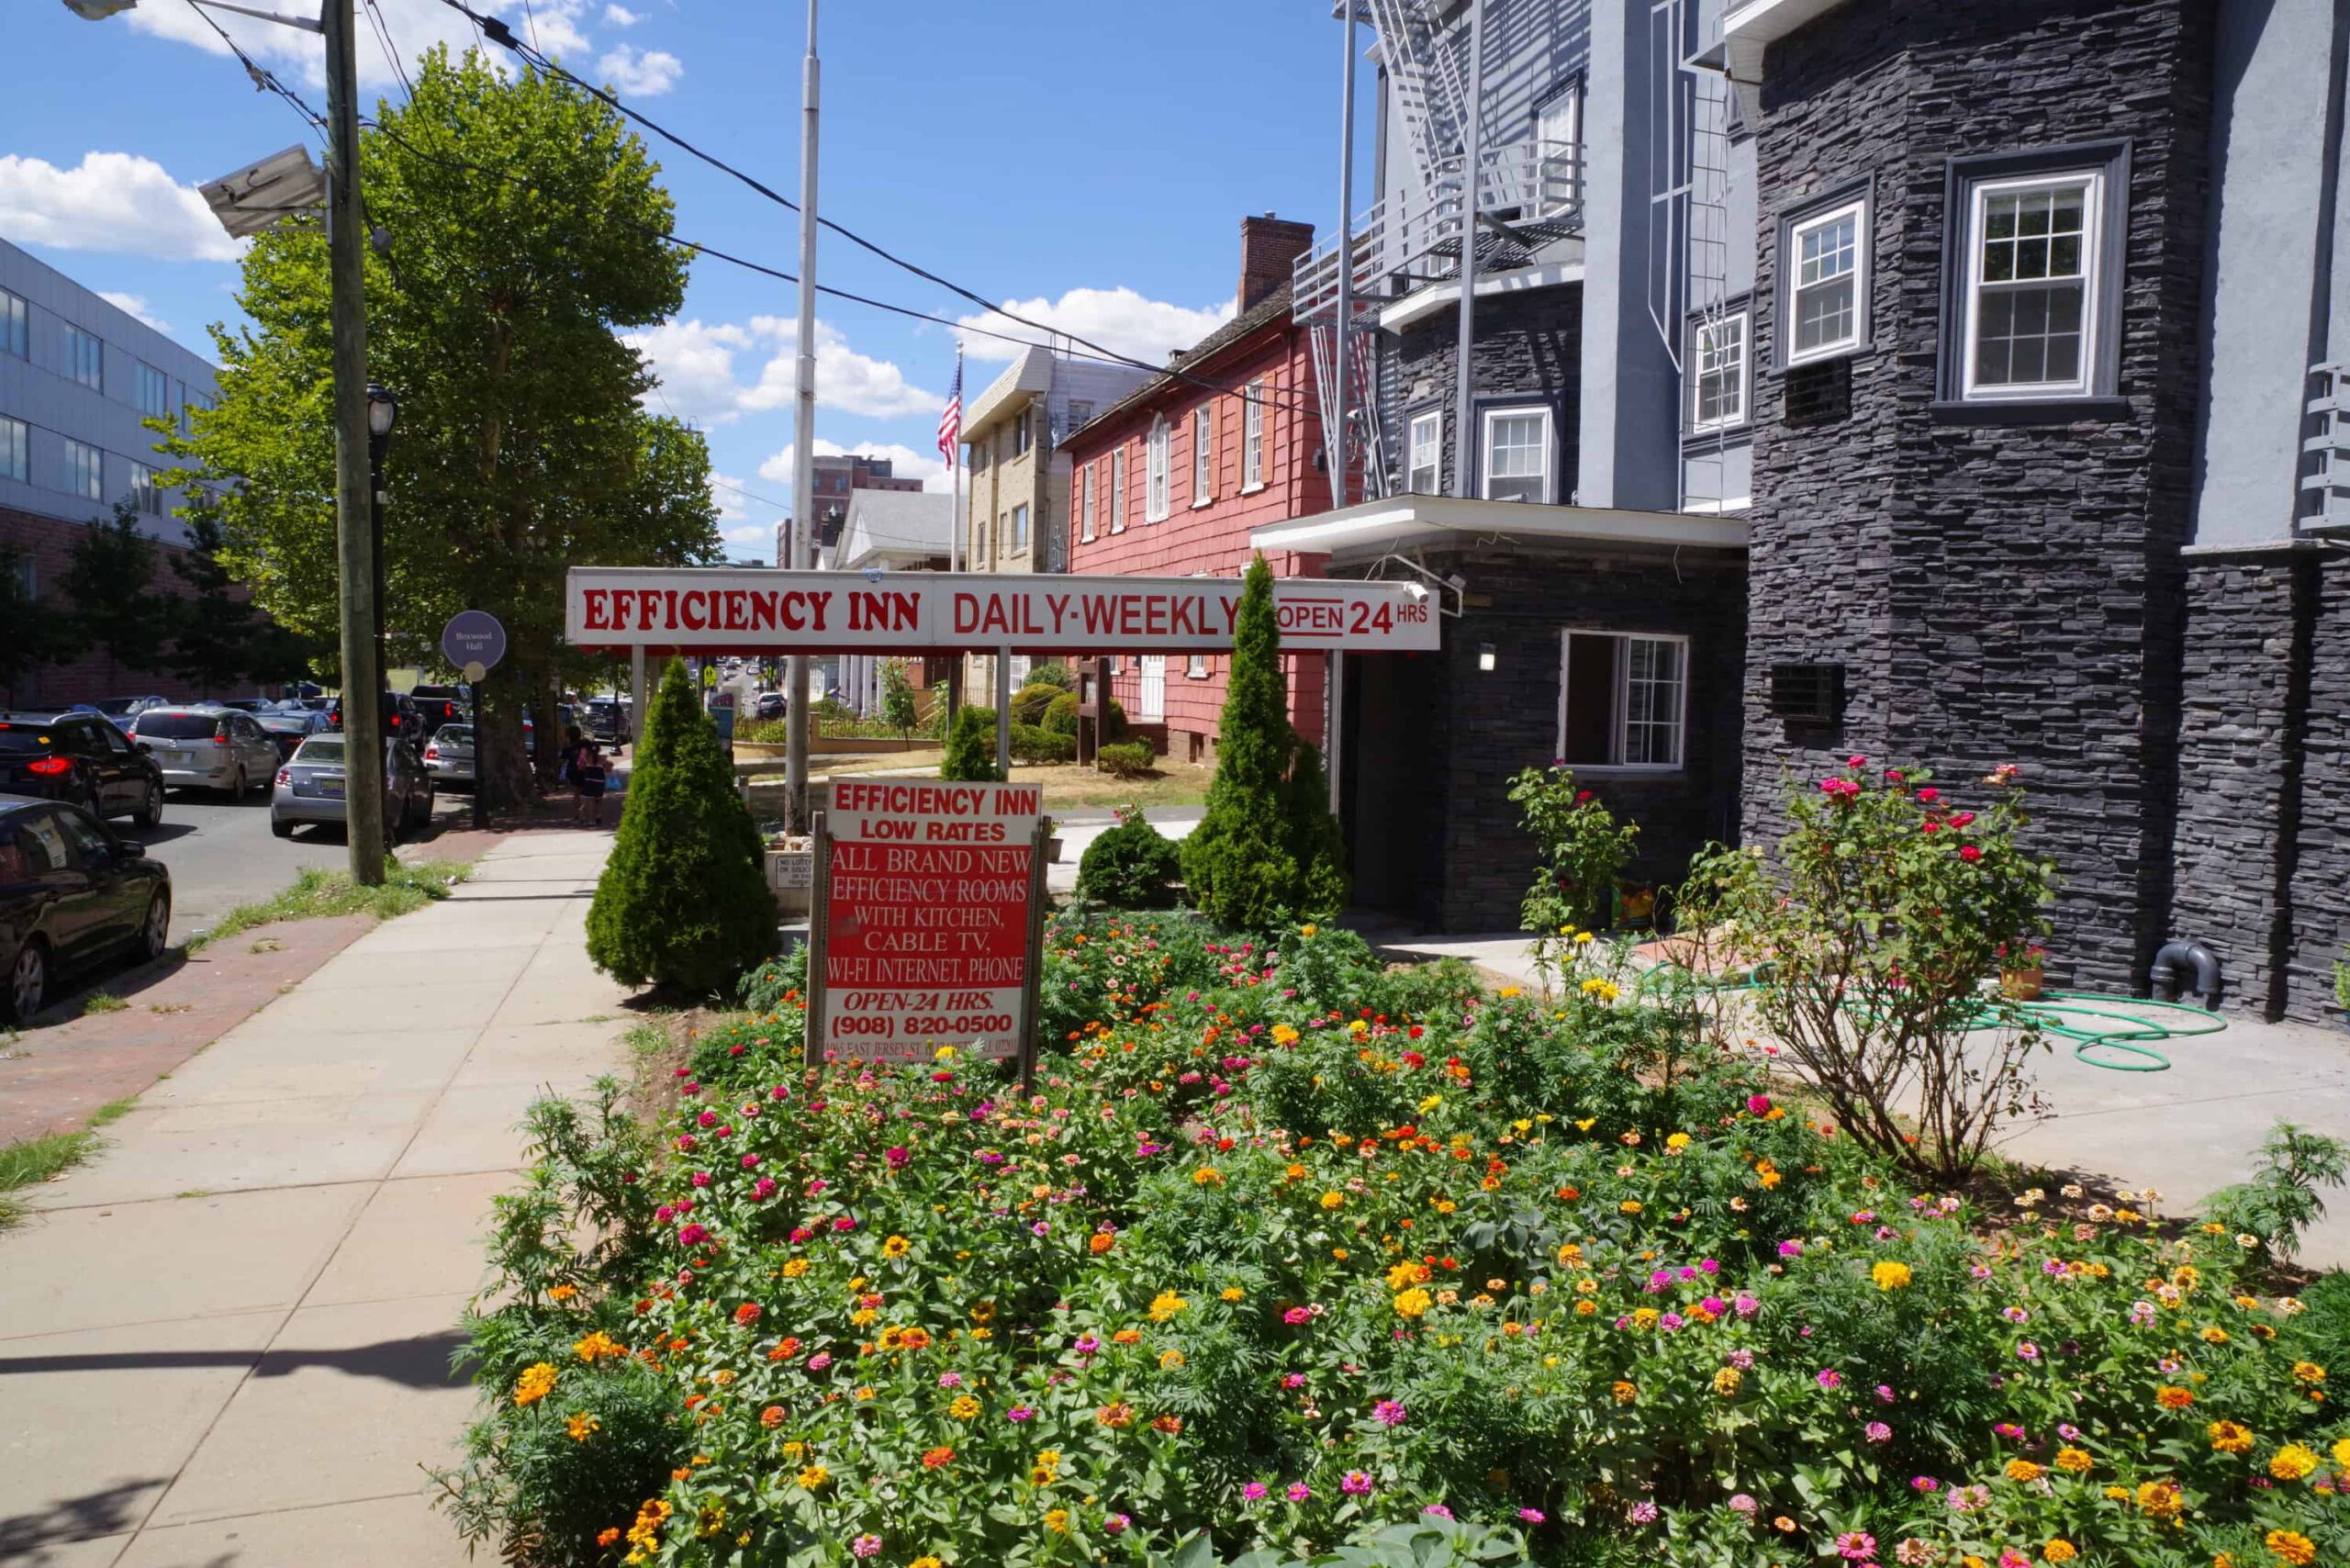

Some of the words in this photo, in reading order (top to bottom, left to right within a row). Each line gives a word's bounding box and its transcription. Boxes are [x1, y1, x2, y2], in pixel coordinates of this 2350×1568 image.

[583, 588, 833, 632] EFFICIENCY
[847, 591, 921, 632] INN
[1277, 606, 1343, 629] OPEN
[1349, 600, 1393, 634] 24
[1397, 603, 1428, 623] HRS
[465, 642, 483, 651] Hall
[835, 783, 986, 815] EFFICIENCY
[994, 789, 1037, 816] INN
[860, 819, 918, 841] LOW
[926, 821, 1006, 842] RATES
[830, 846, 878, 871] ALL
[888, 848, 972, 873] BRAND
[978, 849, 1033, 874] NEW
[832, 875, 955, 902] EFFICIENCY
[957, 879, 1027, 903] ROOMS
[854, 905, 908, 927] WITH
[914, 906, 1005, 928] KITCHEN,
[864, 931, 948, 952] CABLE
[957, 931, 991, 954] TV,
[827, 957, 871, 982] WI-FI
[876, 957, 963, 984] INTERNET,
[968, 957, 1024, 982] PHONE
[843, 991, 940, 1012] OPEN-24
[946, 991, 994, 1011] HRS.
[832, 1015, 895, 1038] (908)
[903, 1014, 1013, 1036] 820-0500
[846, 1041, 870, 1056] EAST
[874, 1041, 907, 1057] JERSEY
